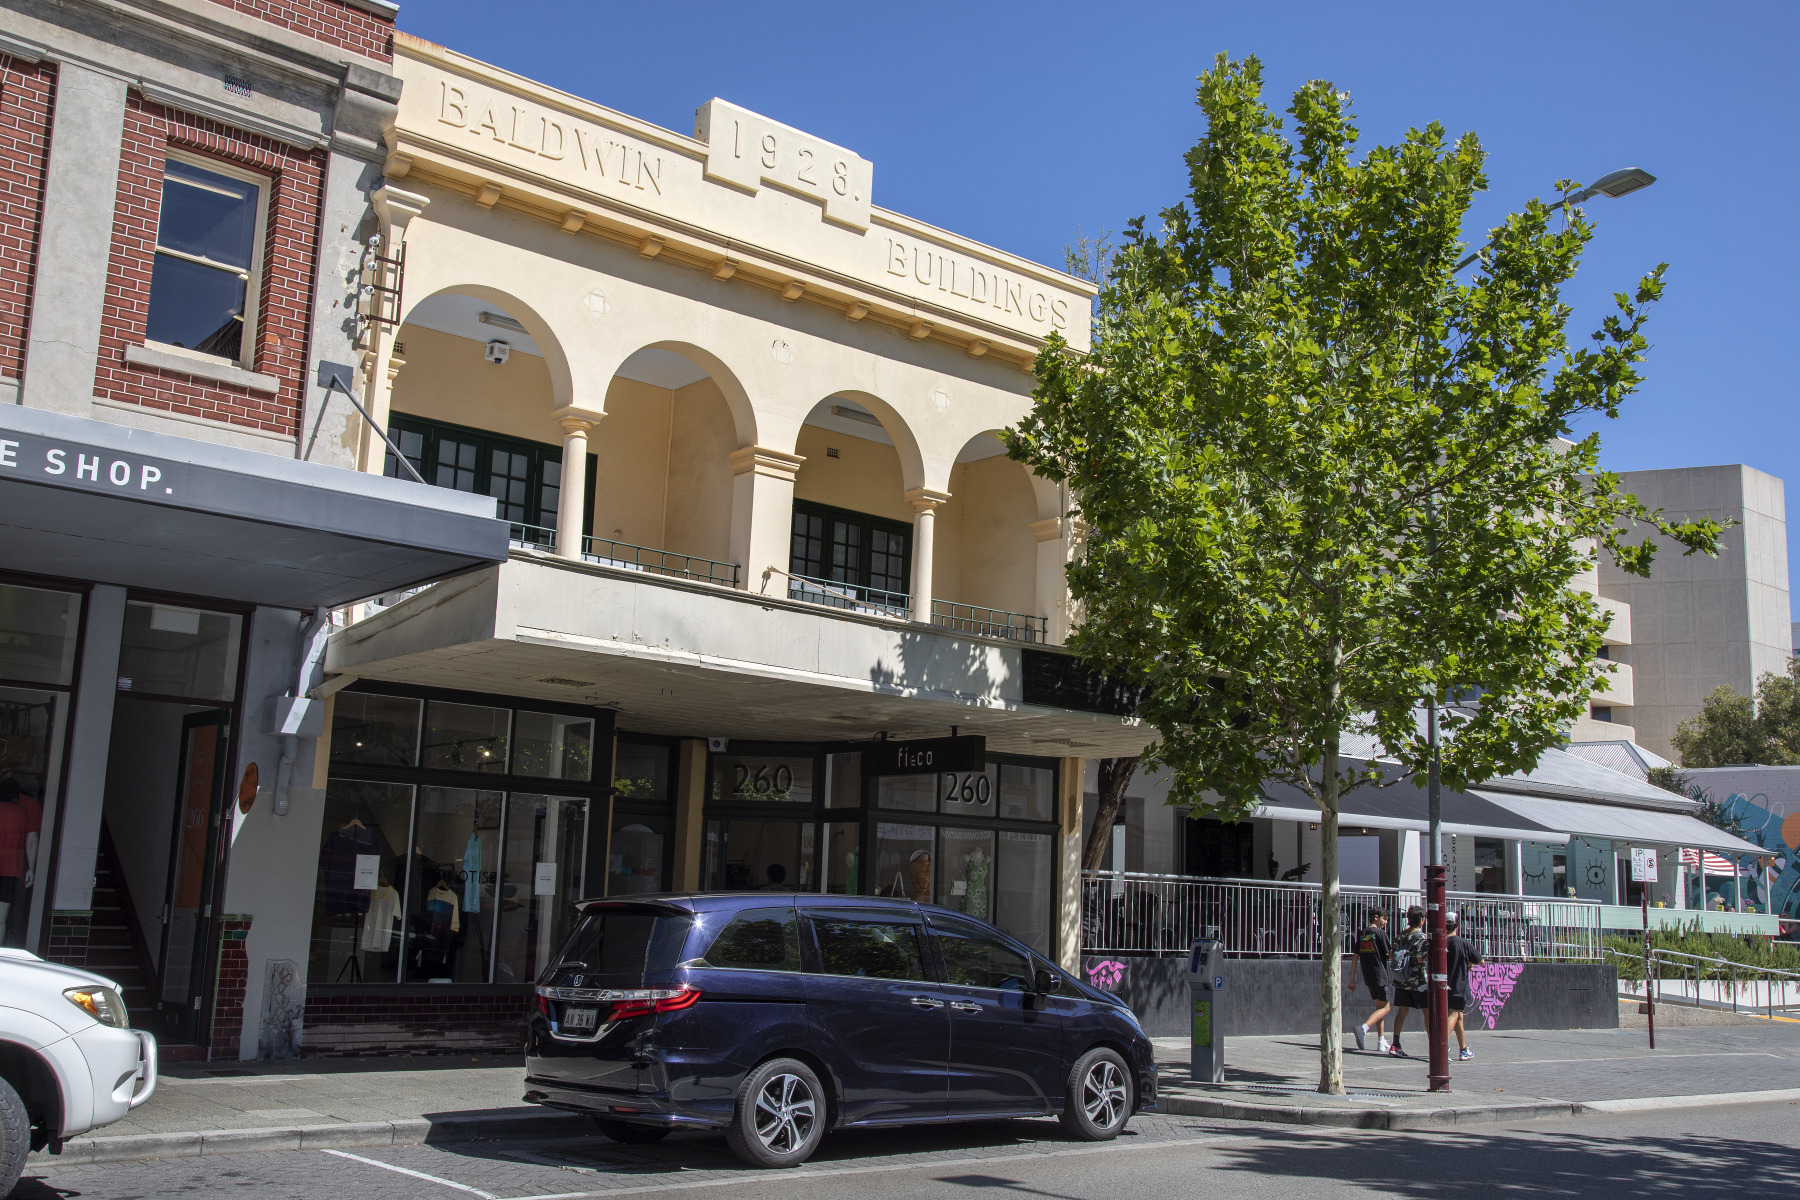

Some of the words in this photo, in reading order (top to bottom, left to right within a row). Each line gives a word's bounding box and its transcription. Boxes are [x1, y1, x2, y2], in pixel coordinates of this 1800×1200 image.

[438, 80, 665, 196] BALDWIN
[887, 237, 1068, 330] BUILDINGS
[44, 448, 173, 495] SHOP.
[733, 763, 794, 795] 260
[945, 772, 992, 806] 260
